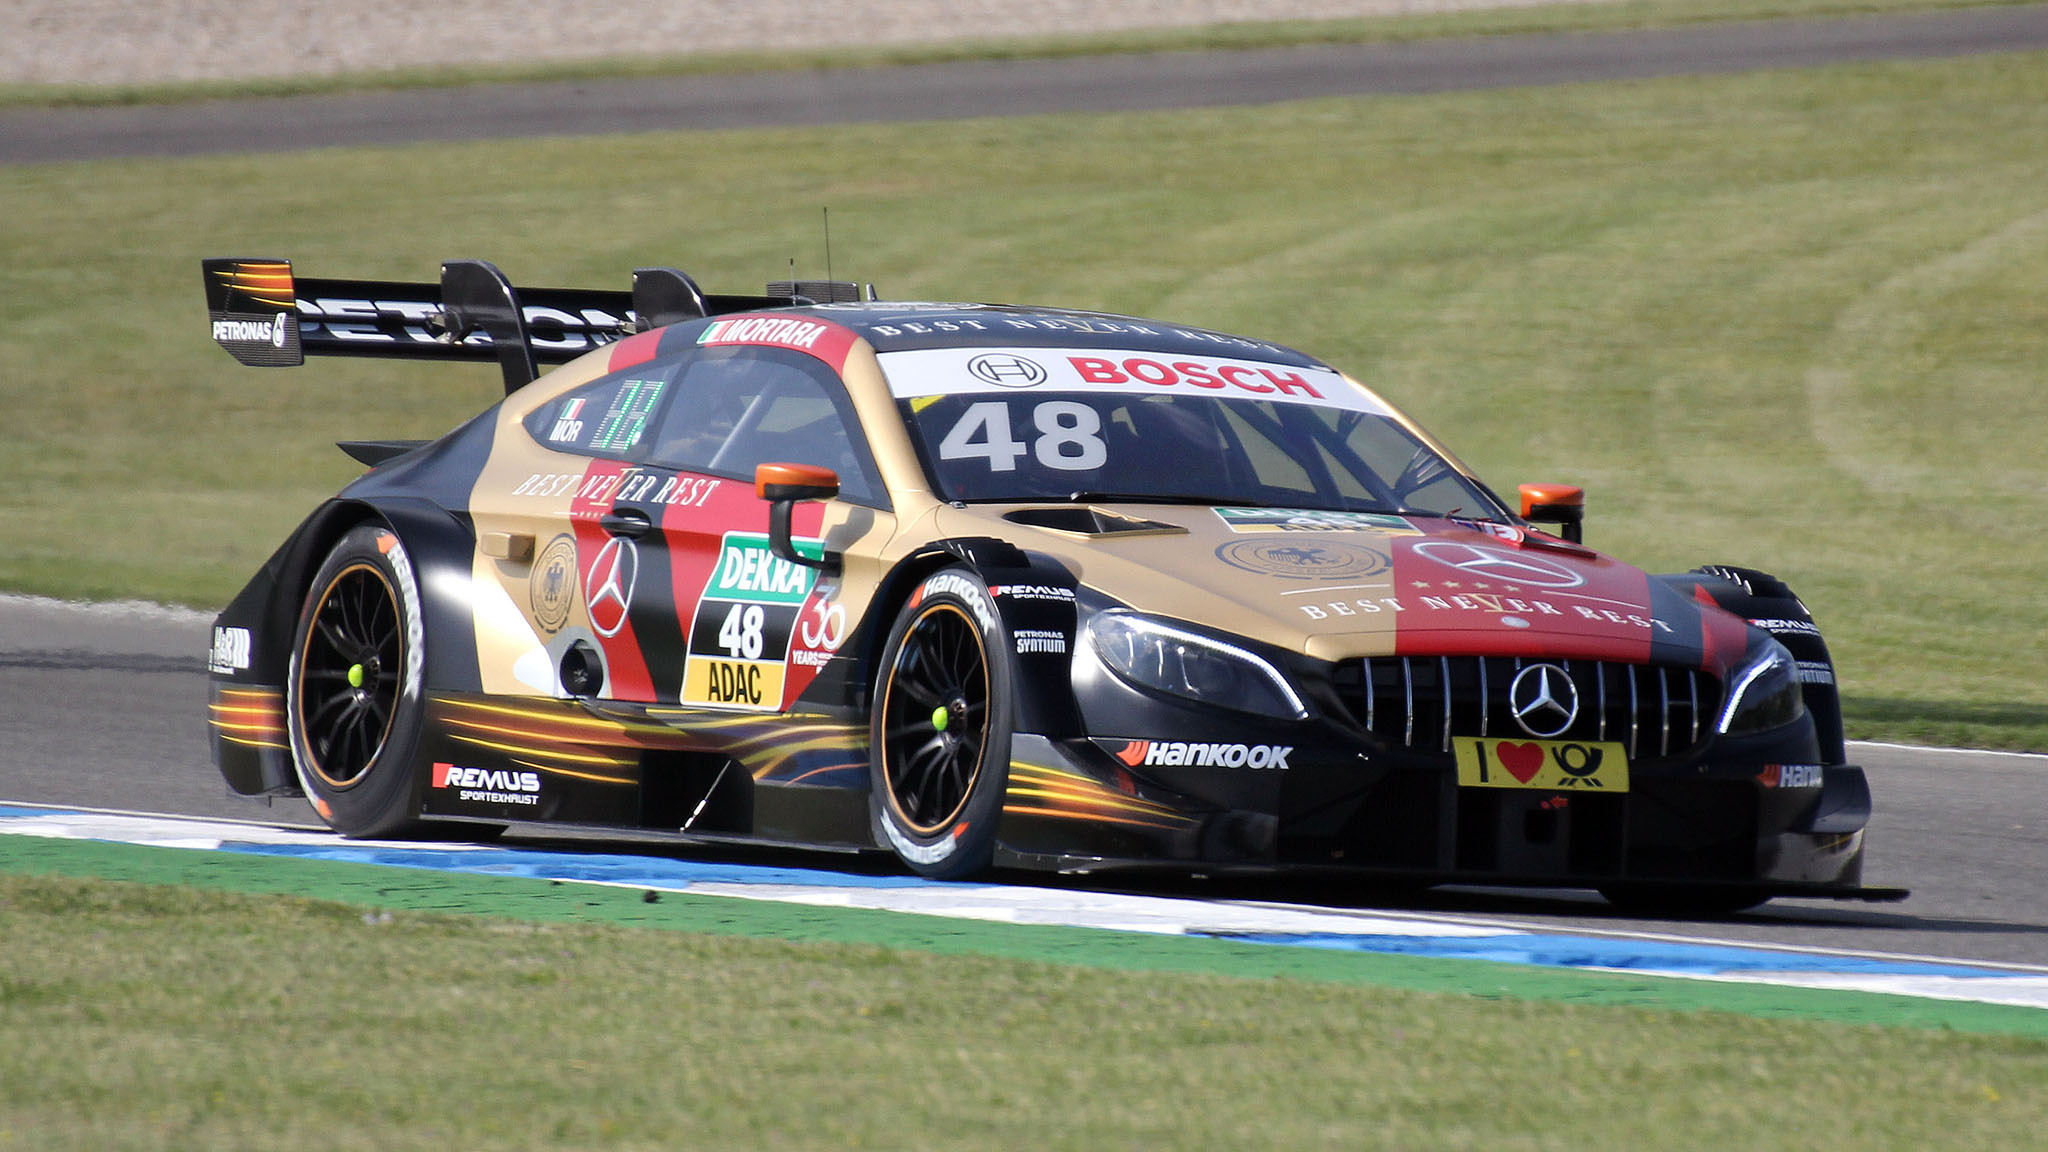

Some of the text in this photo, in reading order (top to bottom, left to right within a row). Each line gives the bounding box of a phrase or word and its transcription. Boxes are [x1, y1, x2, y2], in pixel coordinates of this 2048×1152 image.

[213, 320, 272, 341] PETRONAS
[724, 318, 827, 348] MORTARA
[871, 319, 987, 336] BEST
[1003, 318, 1160, 335] NEVER
[1067, 355, 1327, 399] BOSCH
[550, 420, 583, 442] MOR
[940, 401, 1107, 472] 48
[512, 468, 720, 507] BEST NEVER REST
[719, 546, 807, 594] DEKRA
[997, 585, 1075, 597] REMUS
[1300, 592, 1674, 633] BEST NEVER REST
[719, 604, 764, 659] 48
[1013, 630, 1064, 639] PETRONAS
[792, 650, 818, 665] YEARS
[708, 662, 762, 705] ADAC
[1475, 741, 1489, 782] I
[444, 766, 540, 792] REMUS
[460, 790, 539, 805] SPORTEXHAUST
